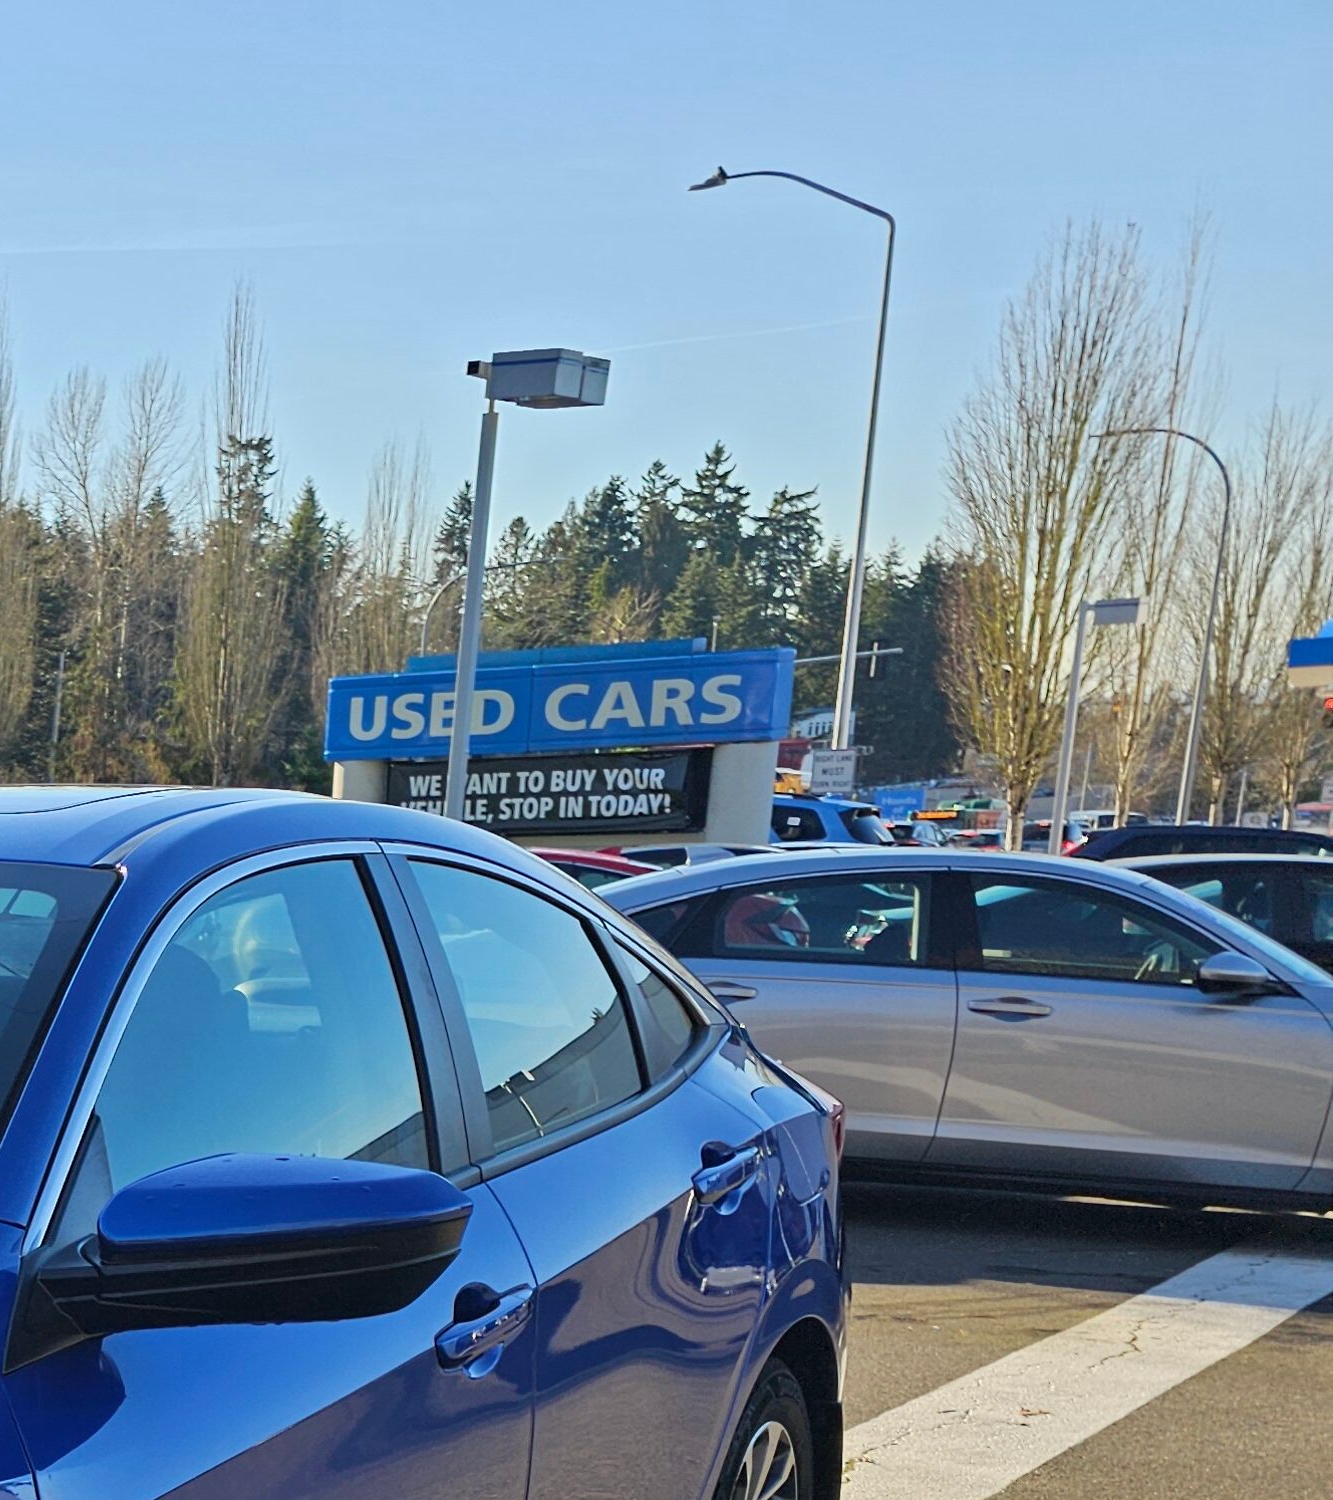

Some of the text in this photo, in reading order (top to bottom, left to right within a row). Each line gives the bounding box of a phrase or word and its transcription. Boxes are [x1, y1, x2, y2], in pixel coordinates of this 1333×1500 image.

[349, 674, 743, 741] USED CARS
[409, 768, 666, 797] WE ANT TO BUY YOUR
[401, 794, 671, 823] HILE, STOP IN TODAY!
